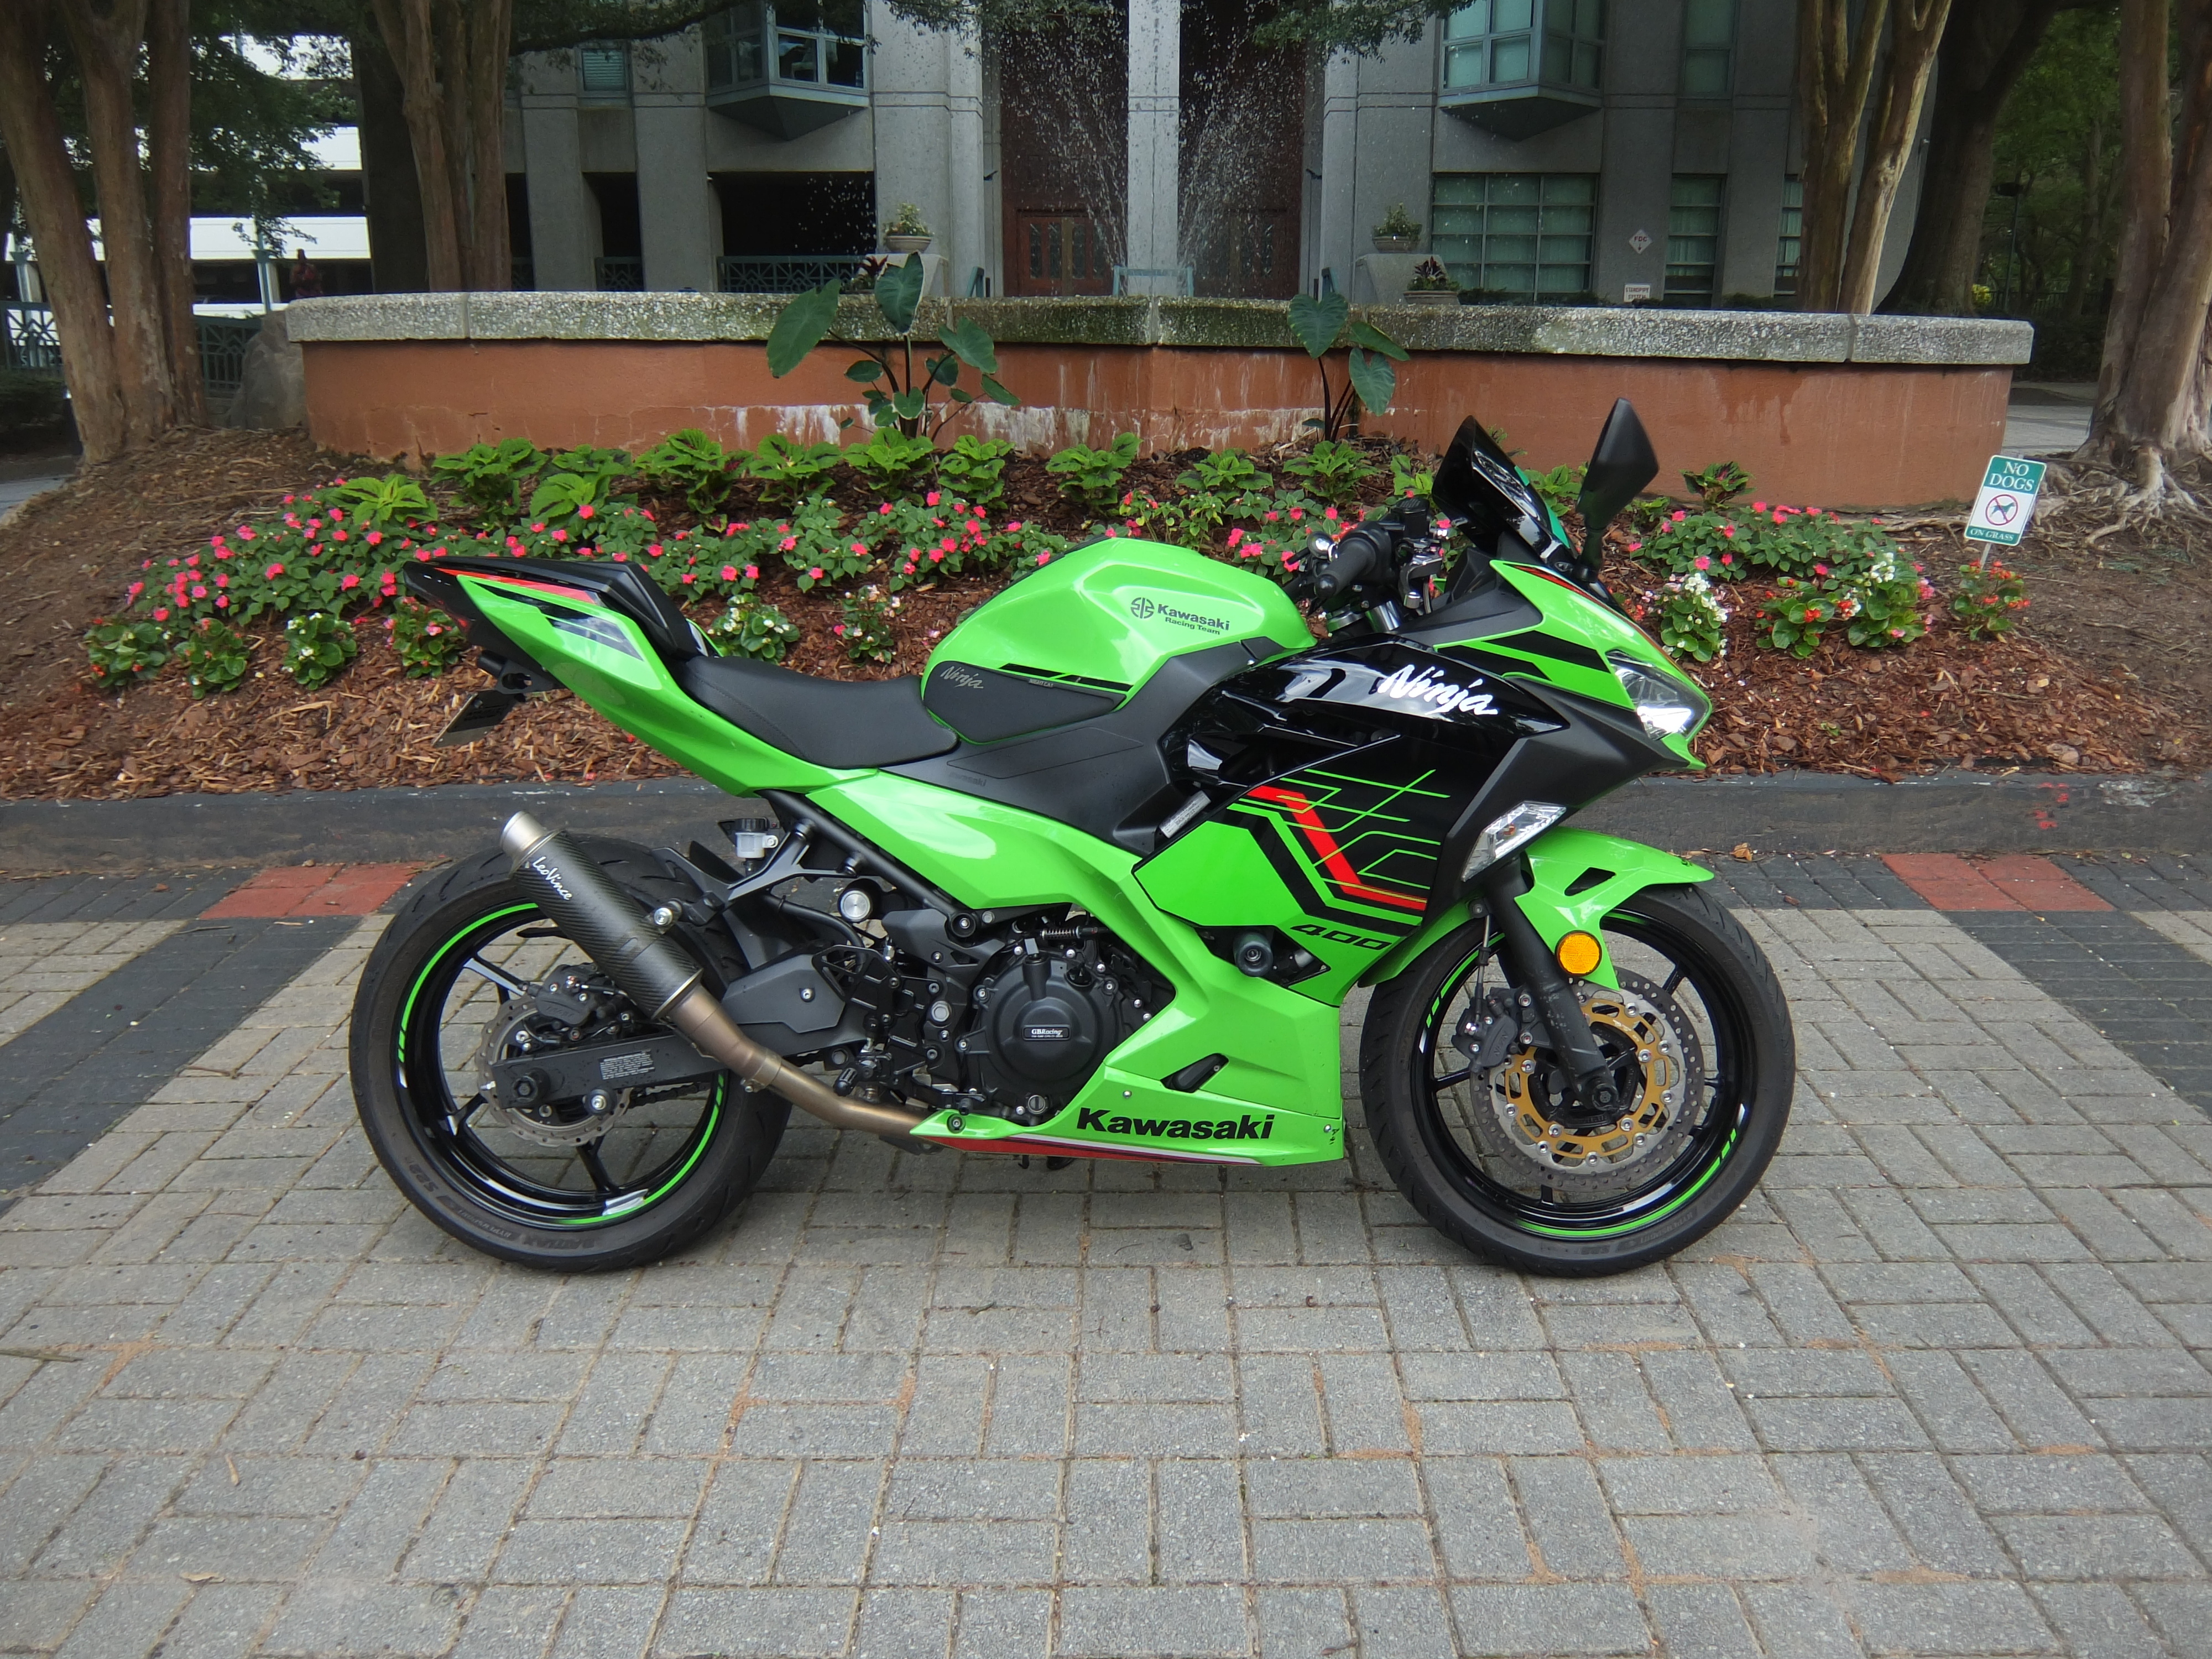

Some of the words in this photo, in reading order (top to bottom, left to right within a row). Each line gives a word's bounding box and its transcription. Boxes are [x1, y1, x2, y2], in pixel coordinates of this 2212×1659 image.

[2003, 461, 2030, 476] NO
[1989, 473, 2034, 492] DOGS
[1970, 528, 1984, 536] ON
[1984, 530, 2013, 541] GRASS
[1157, 603, 1230, 631] Kawasaki
[1165, 617, 1196, 630] Racing
[1197, 624, 1220, 635] Team
[940, 665, 984, 689] Ninja
[1376, 664, 1498, 716] Ninja
[532, 855, 573, 900] LeoVince
[1290, 924, 1392, 951] 400
[1077, 1107, 1275, 1140] Kawasaki
